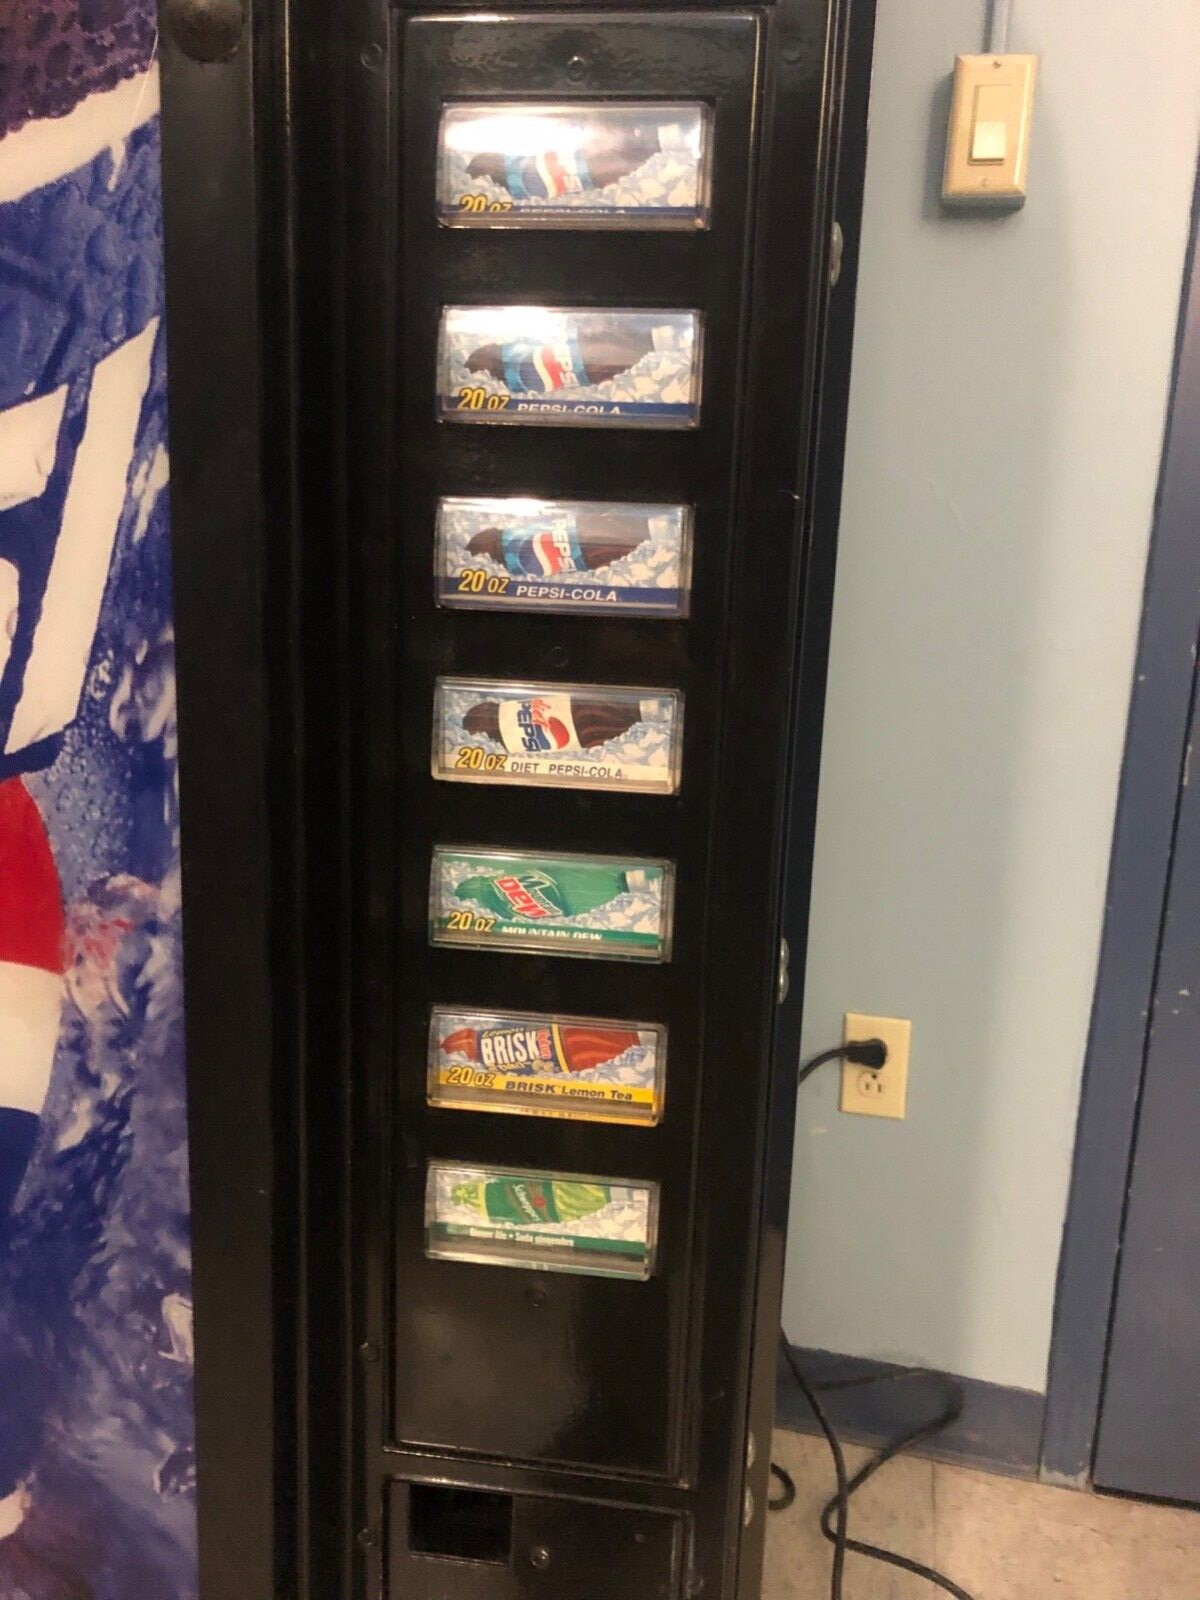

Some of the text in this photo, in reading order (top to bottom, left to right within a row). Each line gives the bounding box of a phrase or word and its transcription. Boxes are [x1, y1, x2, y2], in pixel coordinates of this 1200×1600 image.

[460, 193, 487, 212] 20
[456, 387, 486, 411] 20
[457, 570, 487, 593] 20
[516, 585, 618, 602] PEPSI-COLA
[455, 747, 483, 770] 20
[511, 762, 540, 774] DIET
[549, 764, 624, 779] PEPSI-COLA
[447, 911, 474, 931] 20
[502, 925, 570, 939] MOUNTAIN
[480, 1029, 541, 1068] BRISK
[447, 1066, 473, 1086] 20
[505, 1080, 556, 1094] BRISK
[562, 1085, 605, 1099] Lemon
[610, 1089, 634, 1100] Tea
